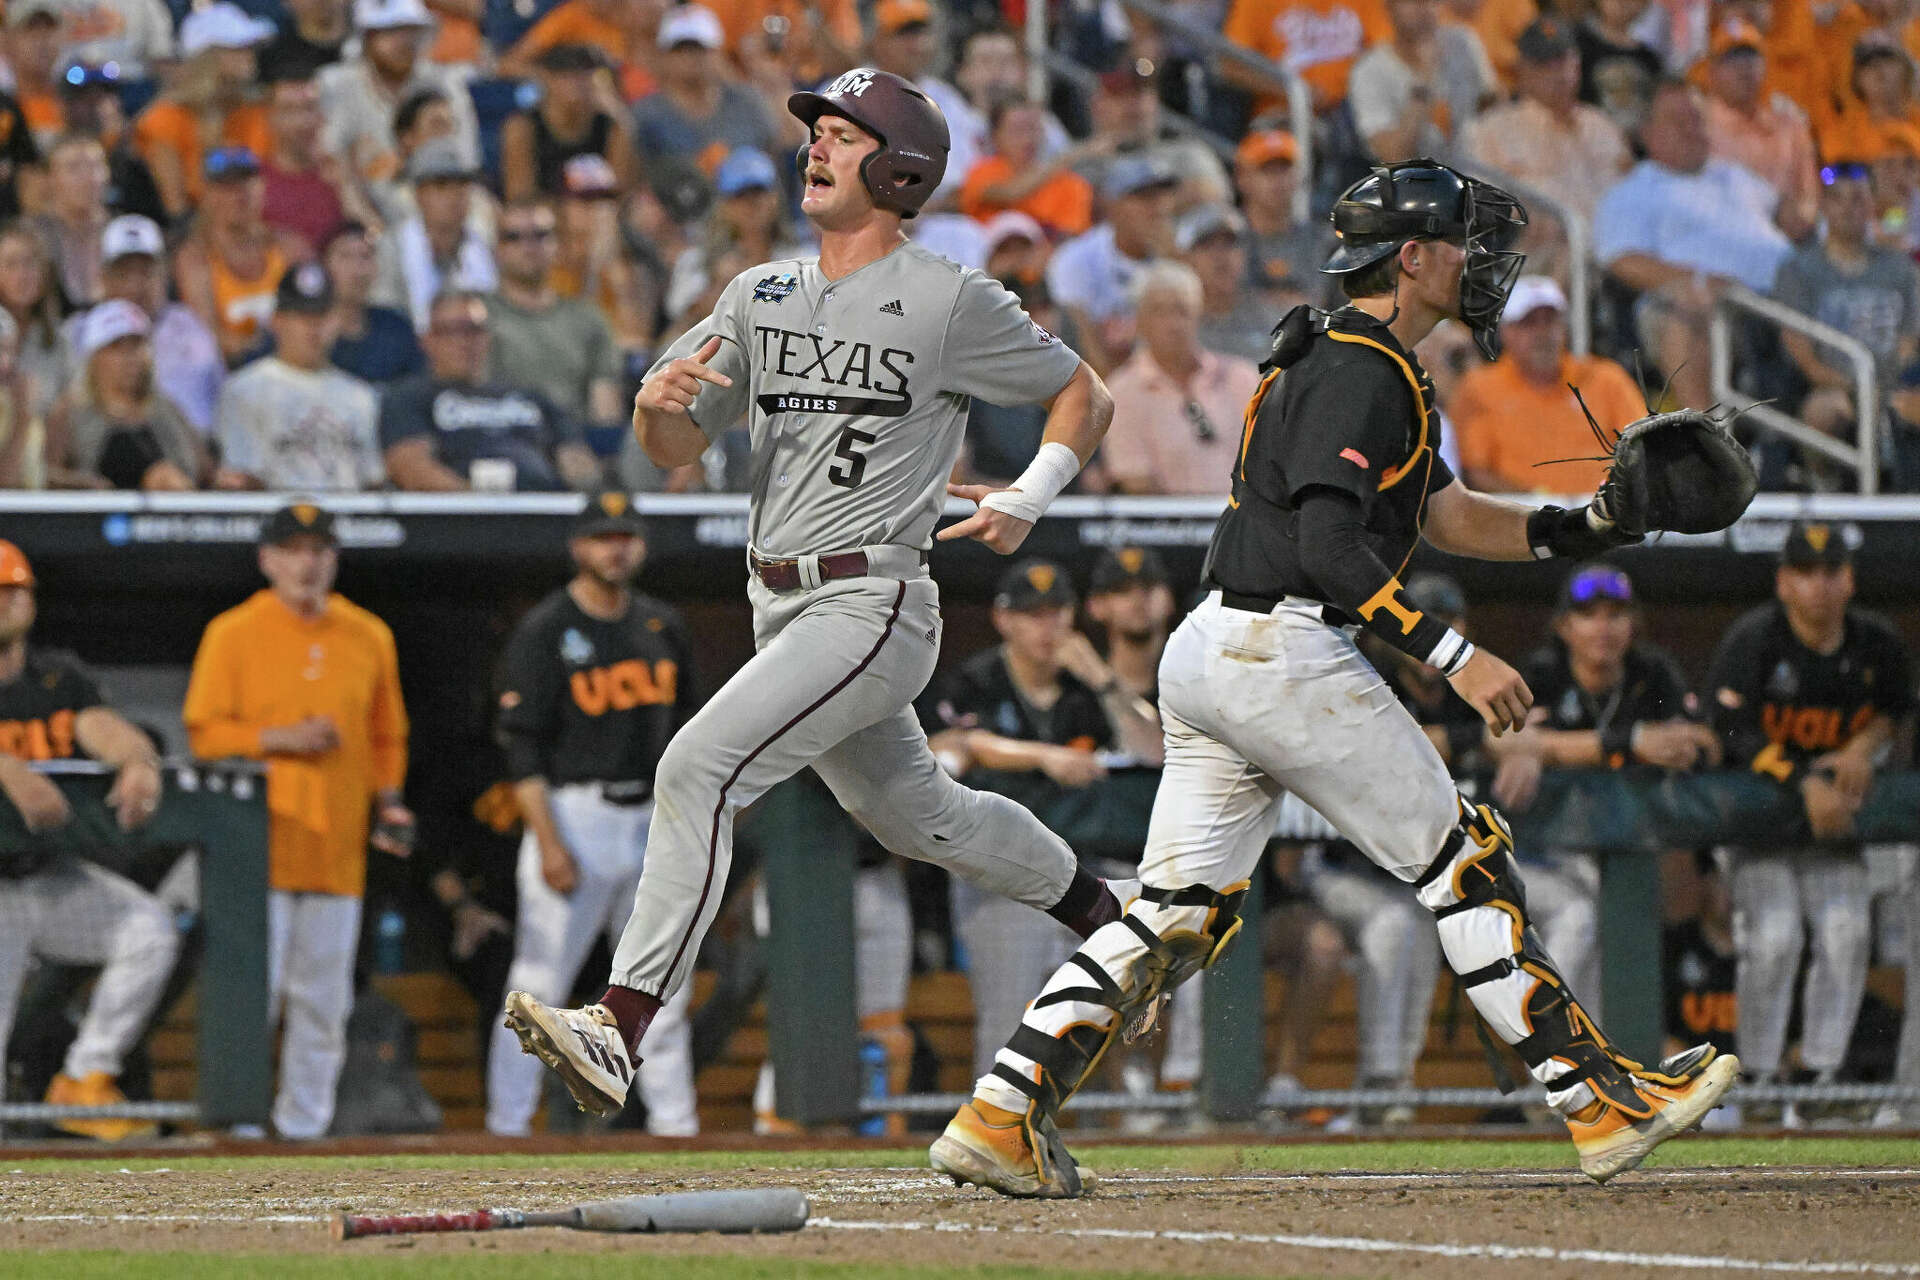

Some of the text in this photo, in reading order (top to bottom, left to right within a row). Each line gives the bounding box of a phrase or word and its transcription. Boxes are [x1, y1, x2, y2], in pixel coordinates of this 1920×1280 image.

[755, 325, 915, 398] TEXAS
[827, 425, 877, 489] 5
[1356, 576, 1424, 636] T
